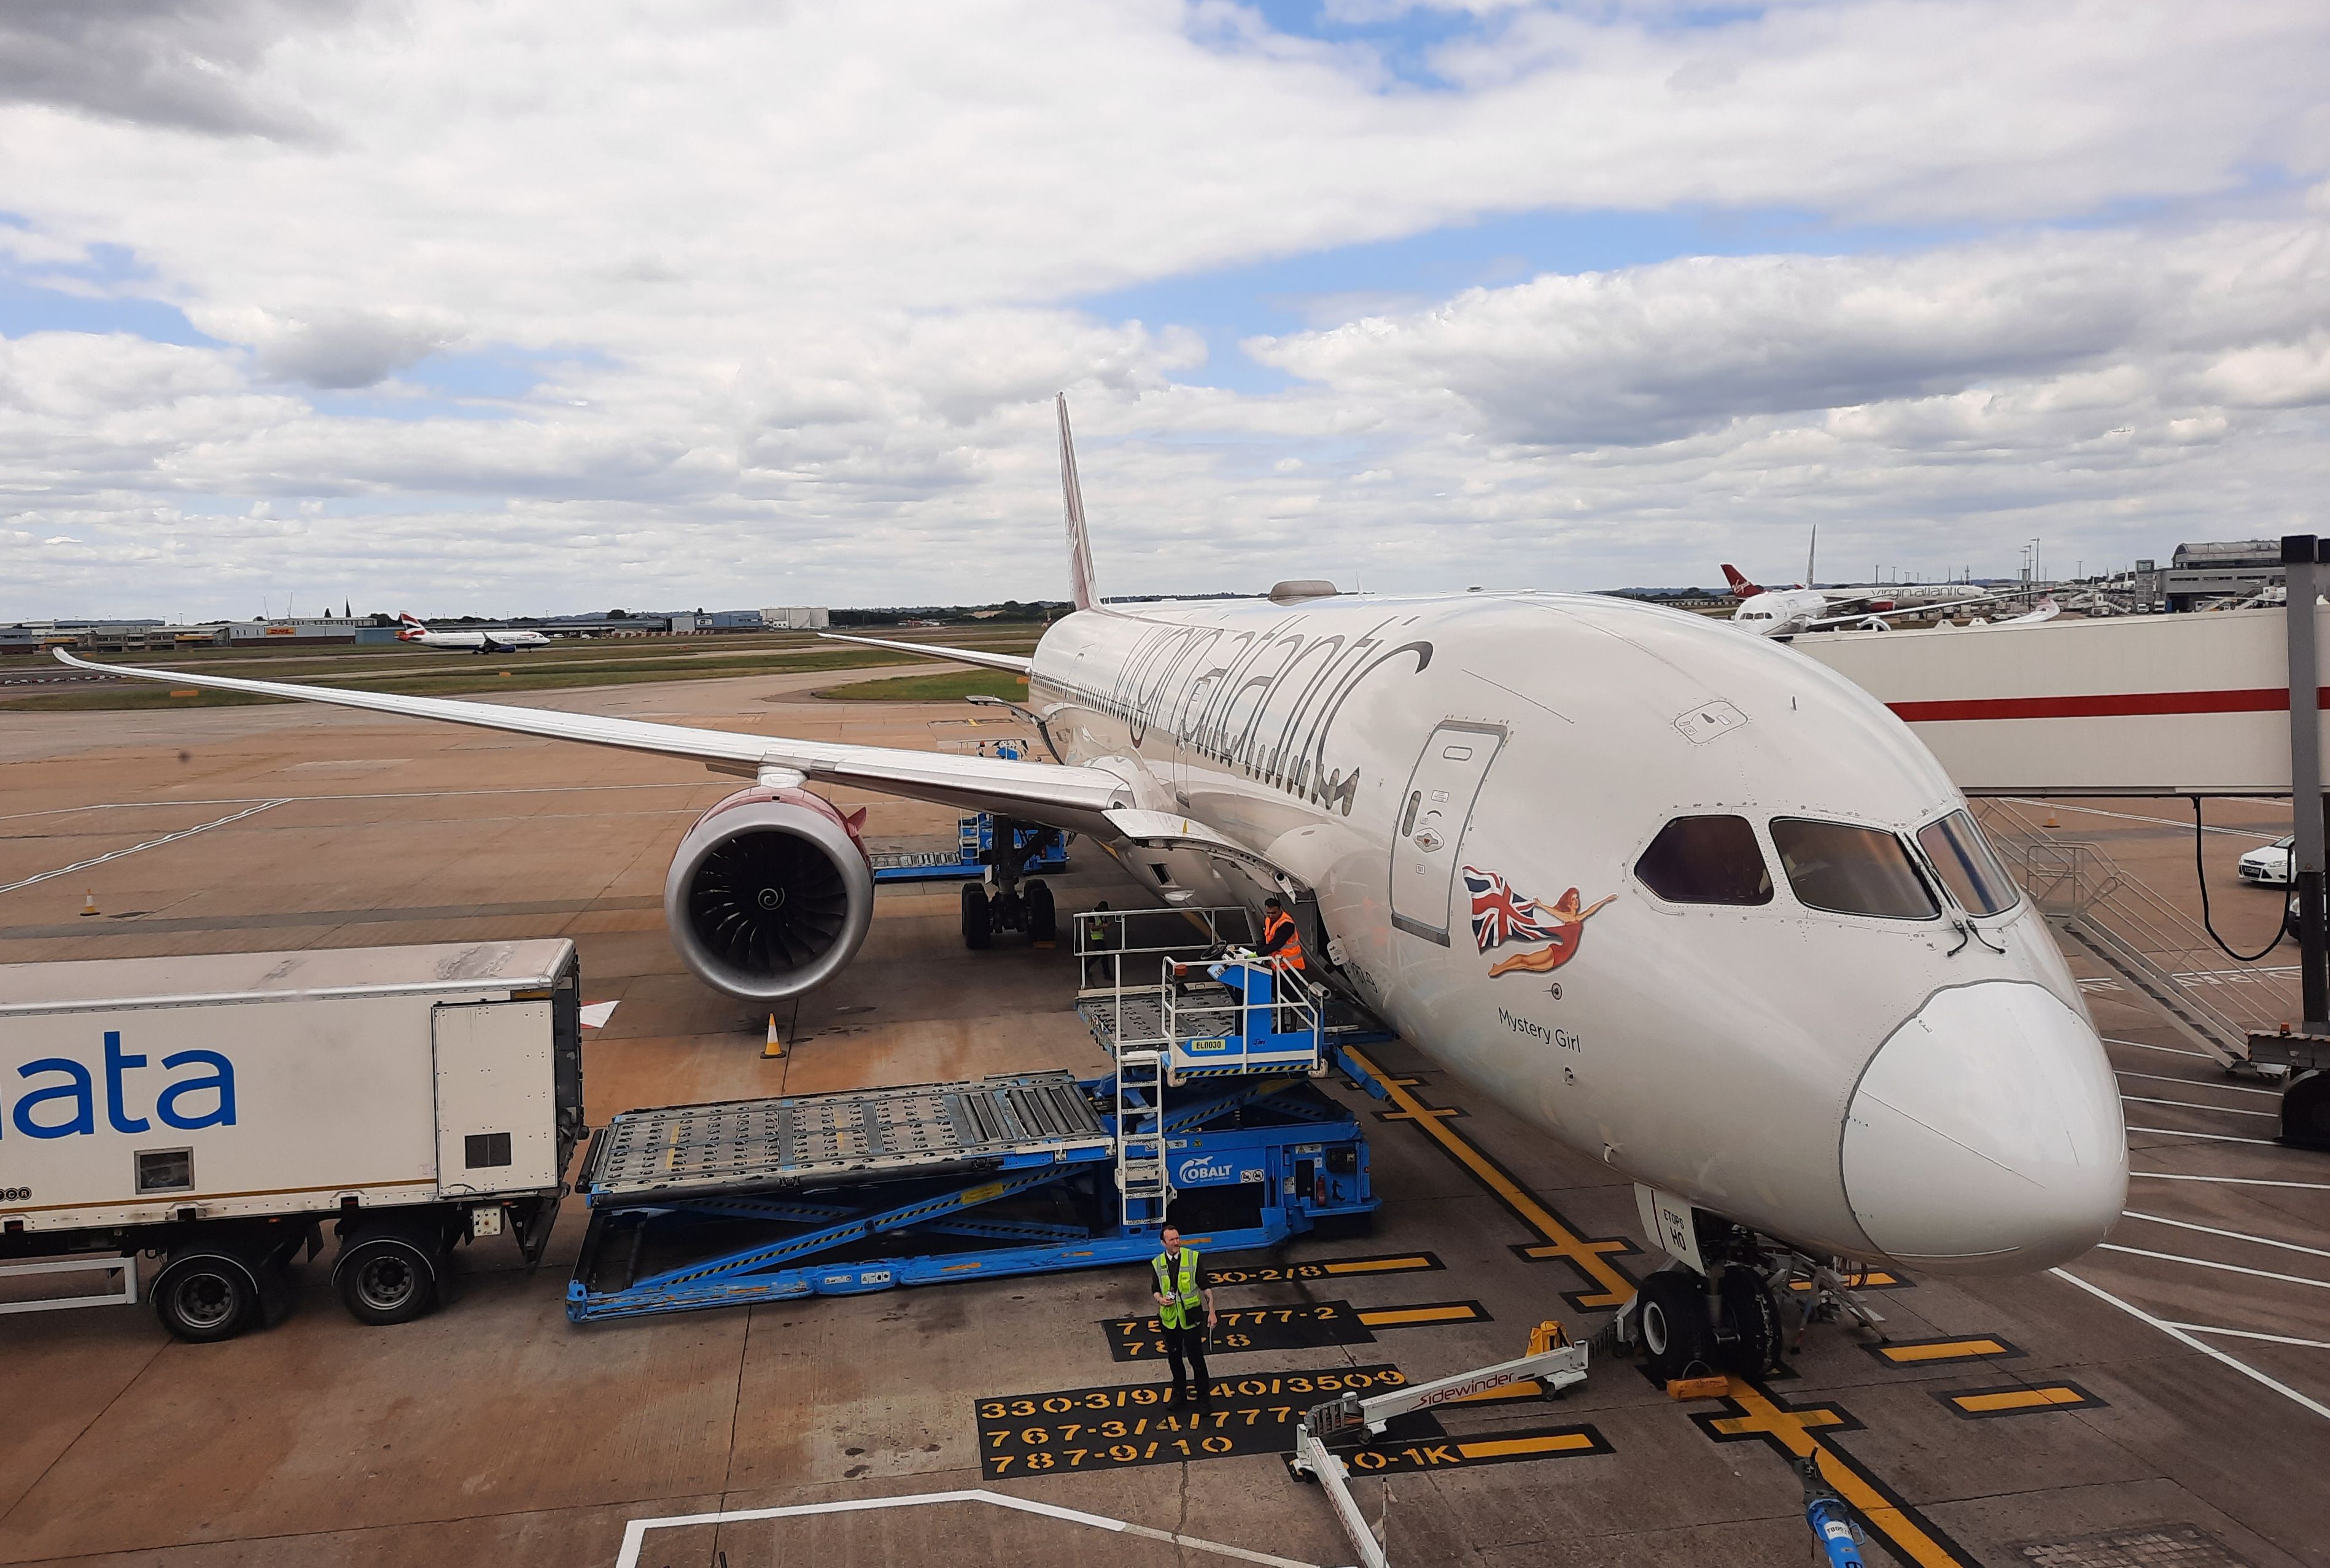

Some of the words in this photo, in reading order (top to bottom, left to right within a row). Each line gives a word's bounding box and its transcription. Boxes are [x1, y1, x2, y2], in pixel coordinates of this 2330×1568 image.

[1498, 1006, 1551, 1045] Mystery
[1555, 1028, 1581, 1054] Girl
[1196, 1041, 1221, 1049] EL0030
[0, 1031, 237, 1141] ata
[1179, 1159, 1233, 1184] COBALT
[1663, 1208, 1685, 1230] ETOPS
[1207, 1266, 1322, 1284] 30-2/8
[1123, 1334, 1251, 1356] 78-8
[986, 1406, 1307, 1448] 767-3/4/777-
[989, 1436, 1233, 1474] 787-9/10
